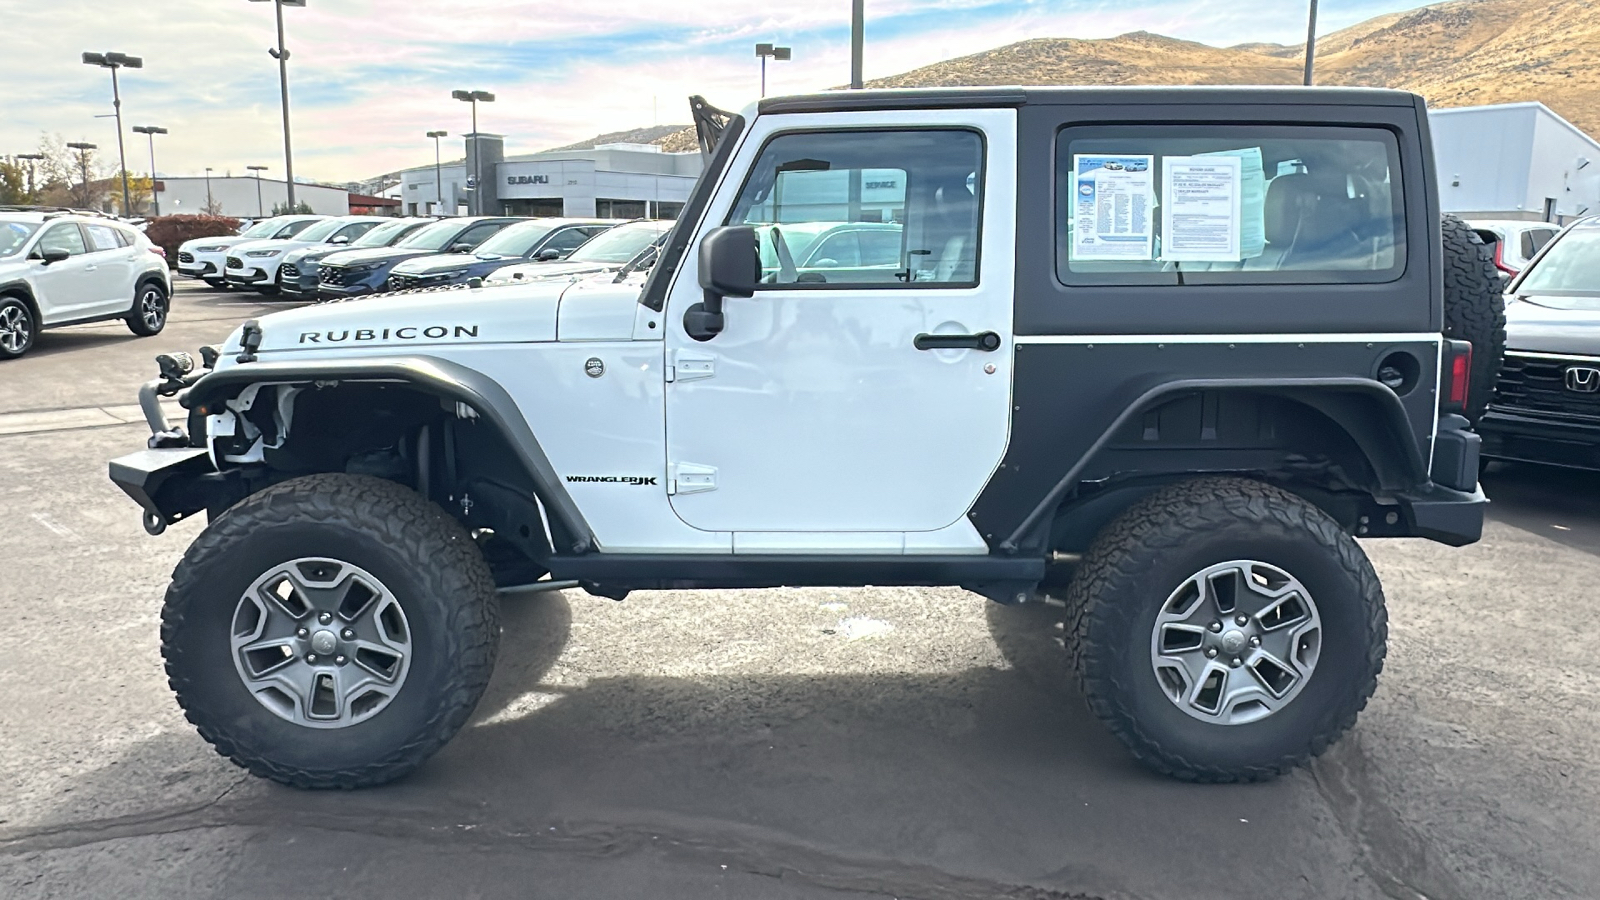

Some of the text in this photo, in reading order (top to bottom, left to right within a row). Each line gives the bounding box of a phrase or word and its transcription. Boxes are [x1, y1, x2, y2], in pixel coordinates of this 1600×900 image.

[507, 175, 549, 185] SUBARU
[865, 180, 897, 189] SERVICE
[299, 325, 478, 344] RUBICON
